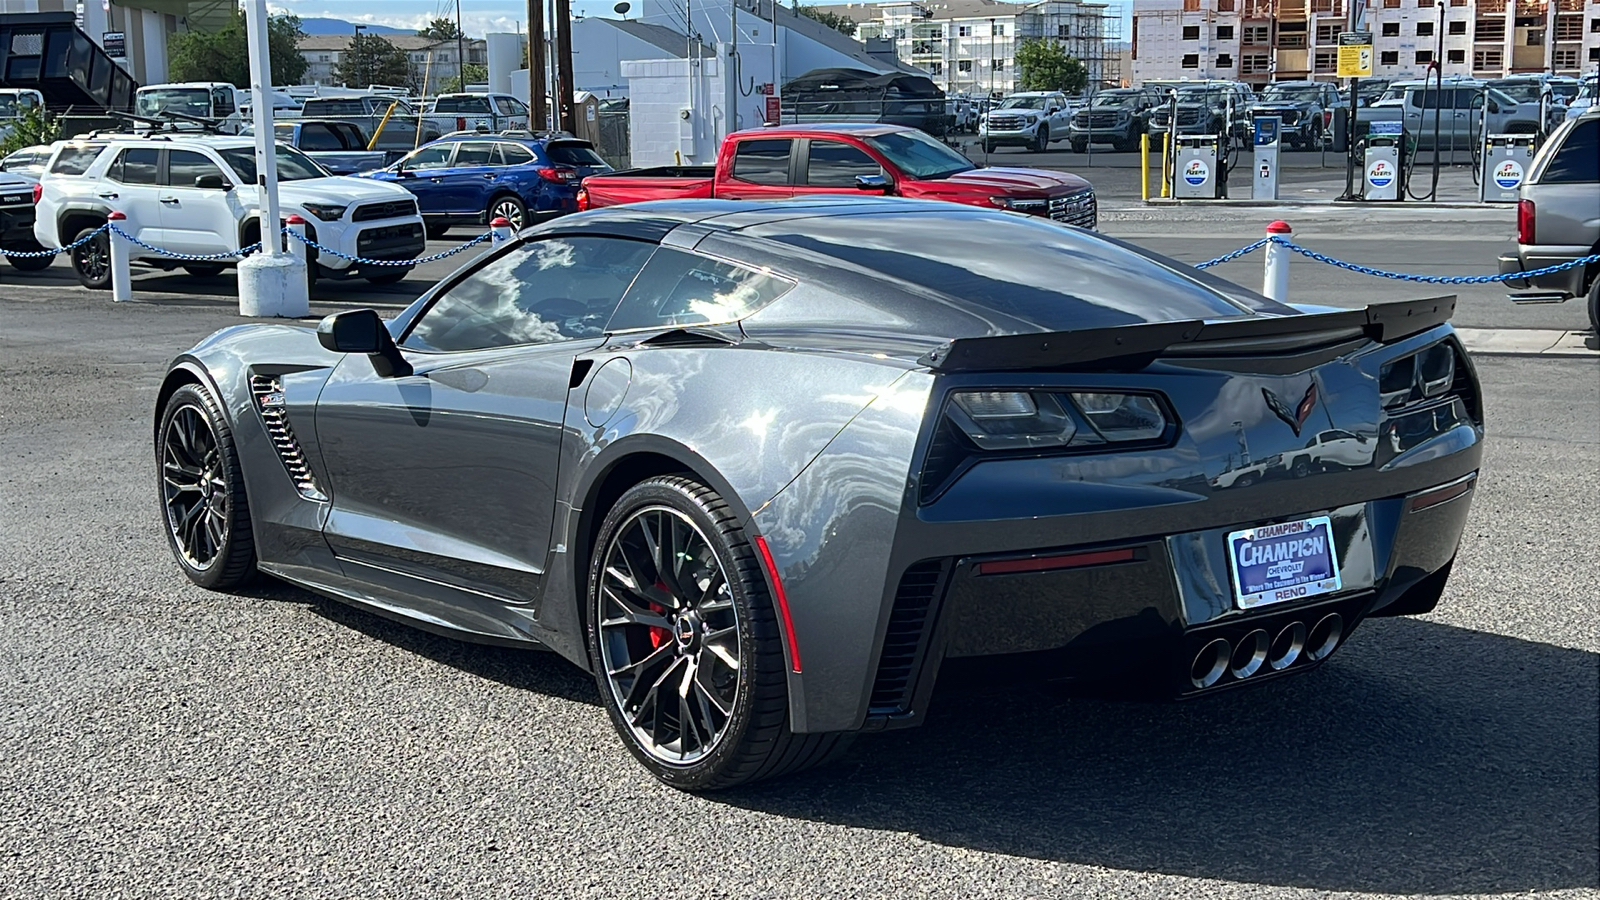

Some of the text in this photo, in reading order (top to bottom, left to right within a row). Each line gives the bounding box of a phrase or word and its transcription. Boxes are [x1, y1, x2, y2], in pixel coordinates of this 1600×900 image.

[1257, 522, 1304, 538] CHAMPION
[1240, 536, 1324, 567] CHAMPION
[1268, 563, 1303, 576] CHEVROLET
[1275, 586, 1307, 600] RENO
